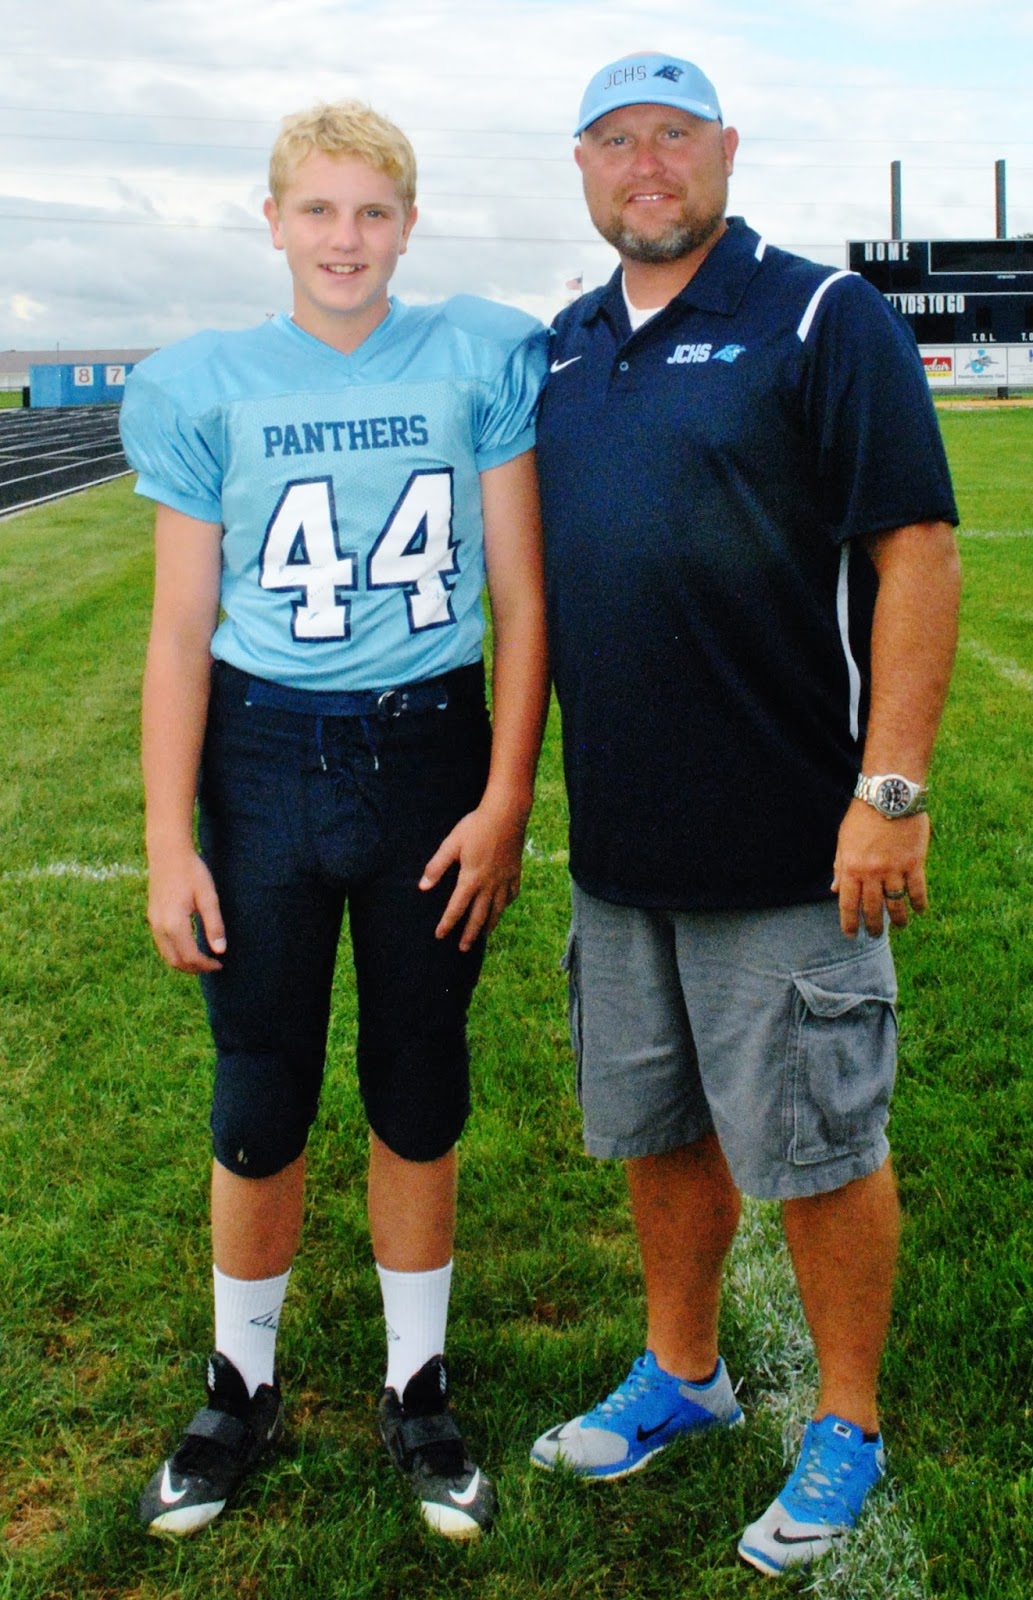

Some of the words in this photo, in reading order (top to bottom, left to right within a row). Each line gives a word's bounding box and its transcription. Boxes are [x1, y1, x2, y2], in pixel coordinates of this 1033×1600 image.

[604, 65, 647, 90] JCHS
[864, 243, 909, 261] HOME
[900, 295, 925, 314] YDS
[928, 295, 945, 314] TO
[946, 295, 965, 314] GO
[666, 343, 712, 364] JCHS
[79, 368, 91, 383] 8
[110, 368, 121, 383] 7
[263, 415, 429, 458] PANTHERS
[258, 467, 462, 643] 44
